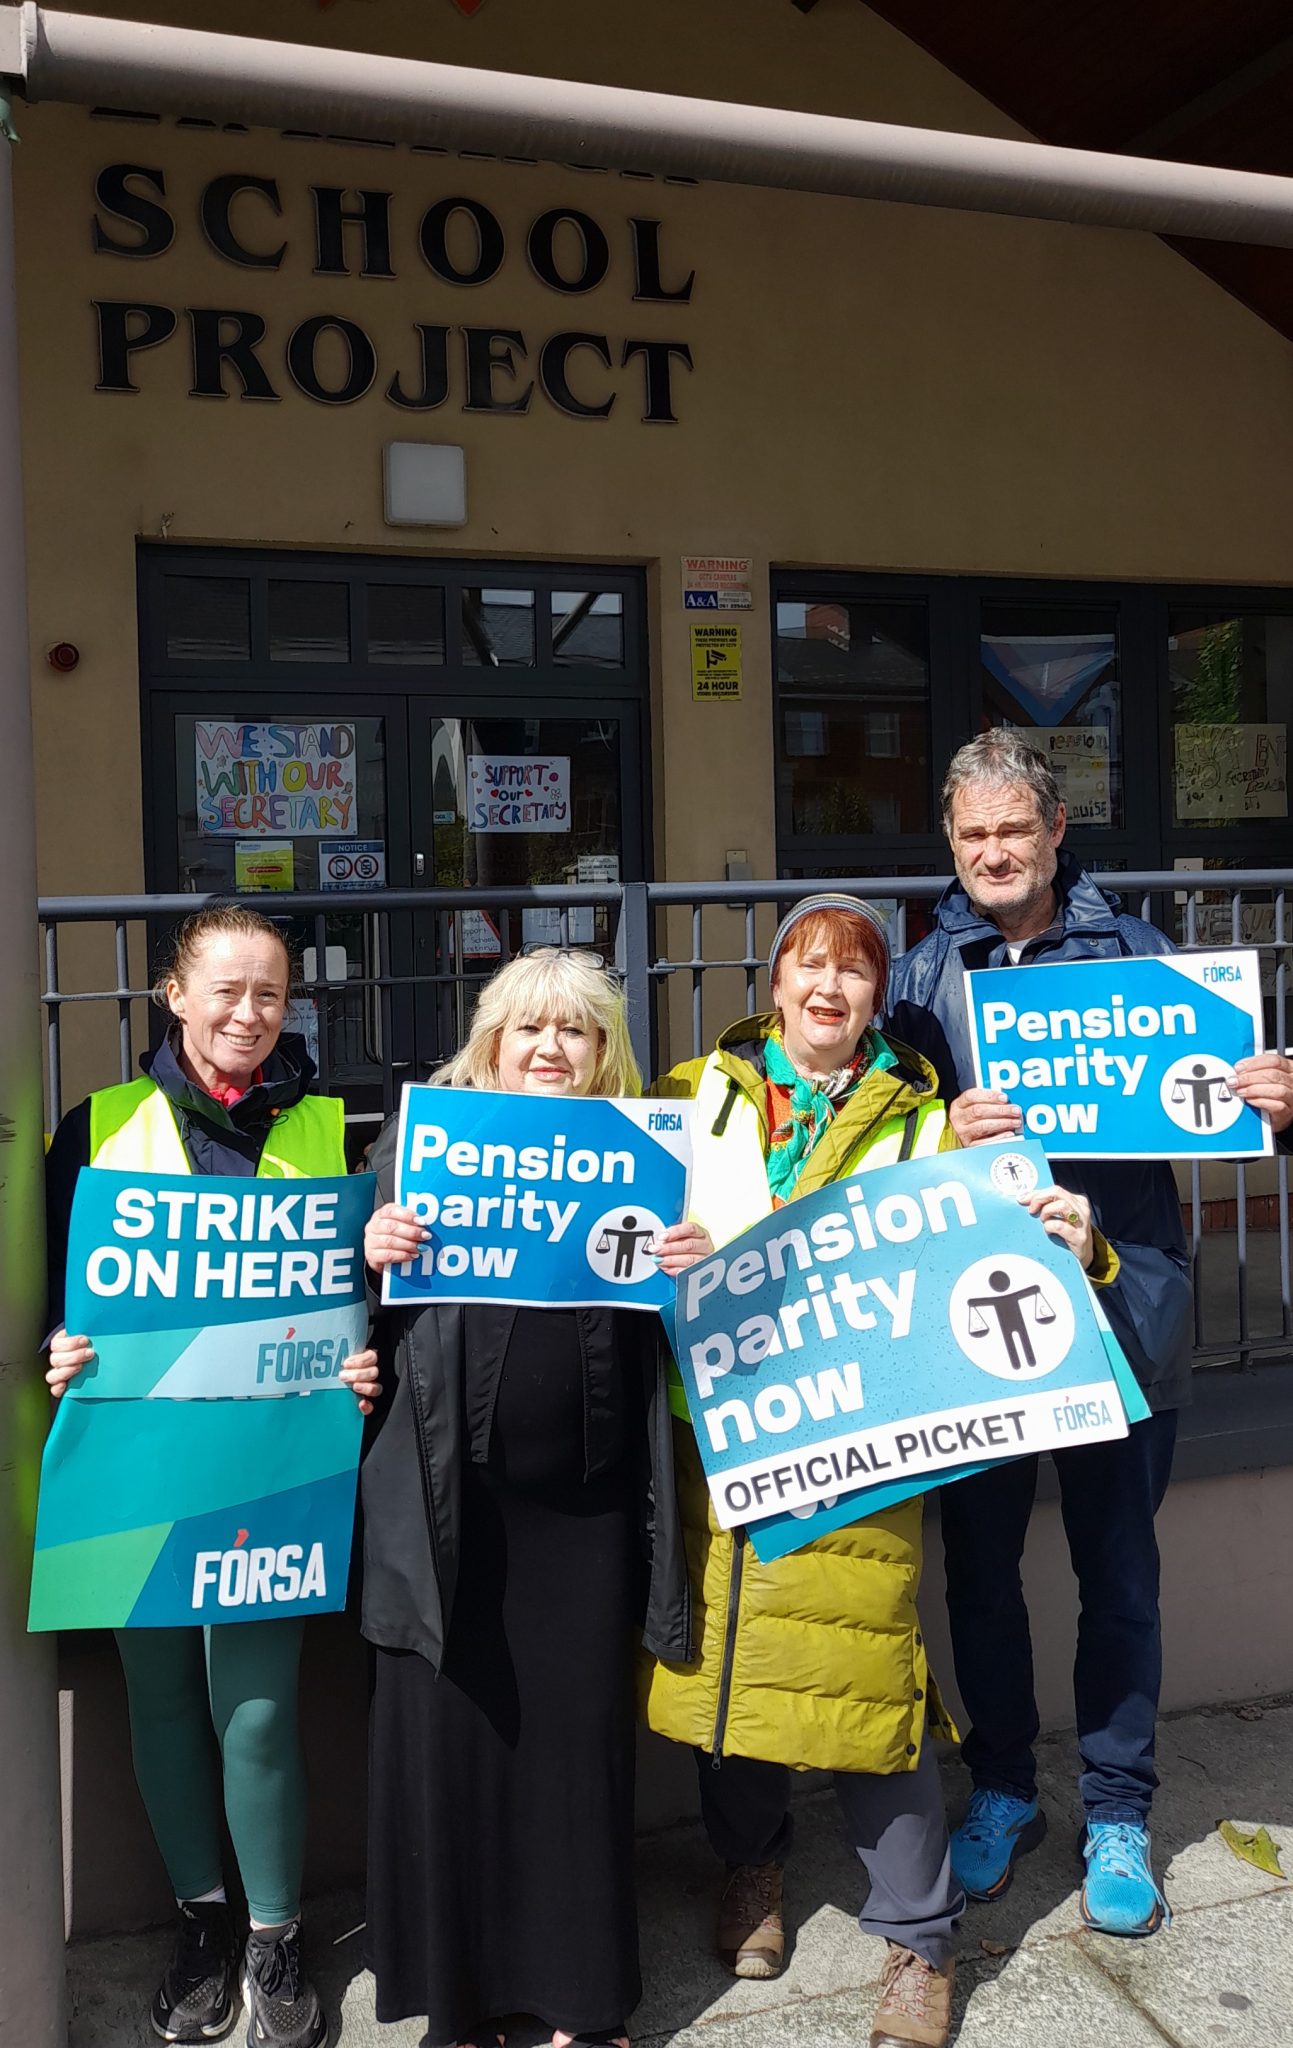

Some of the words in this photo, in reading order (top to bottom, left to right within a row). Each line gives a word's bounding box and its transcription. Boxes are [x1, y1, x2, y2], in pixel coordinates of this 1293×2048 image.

[93, 164, 696, 303] SCHOOL
[92, 299, 695, 424] PROJECT
[686, 559, 748, 571] WARNING
[686, 593, 717, 608] A&A
[694, 628, 737, 636] WARNING
[697, 681, 709, 690] 24
[711, 681, 739, 690] HOUR
[195, 723, 263, 760] WE
[268, 724, 355, 760] STAND
[201, 759, 277, 798] WITH
[282, 760, 345, 792] OUR
[484, 763, 550, 787] SUPPORT
[201, 794, 353, 831] SECRETARY
[338, 844, 368, 853] NOTICE
[1203, 961, 1243, 984] FÓRSA
[981, 994, 1197, 1044] Pension
[988, 1043, 1149, 1096] parity
[648, 1107, 683, 1131] FÓRSA
[1025, 1102, 1098, 1135] ow
[409, 1124, 635, 1184] Pension
[112, 1187, 339, 1242] STRIKE
[405, 1184, 581, 1242] parity
[85, 1246, 180, 1298] ON
[194, 1248, 355, 1299] HERE
[685, 1180, 977, 1323] Pension
[256, 1327, 350, 1384] FÓRSA
[689, 1268, 917, 1399] parity
[703, 1361, 865, 1453] now
[1053, 1396, 1113, 1433] FÓRSA
[723, 1443, 892, 1513] OFFICIAL
[895, 1410, 1027, 1464] PICKET
[191, 1528, 327, 1609] FÓRSA
